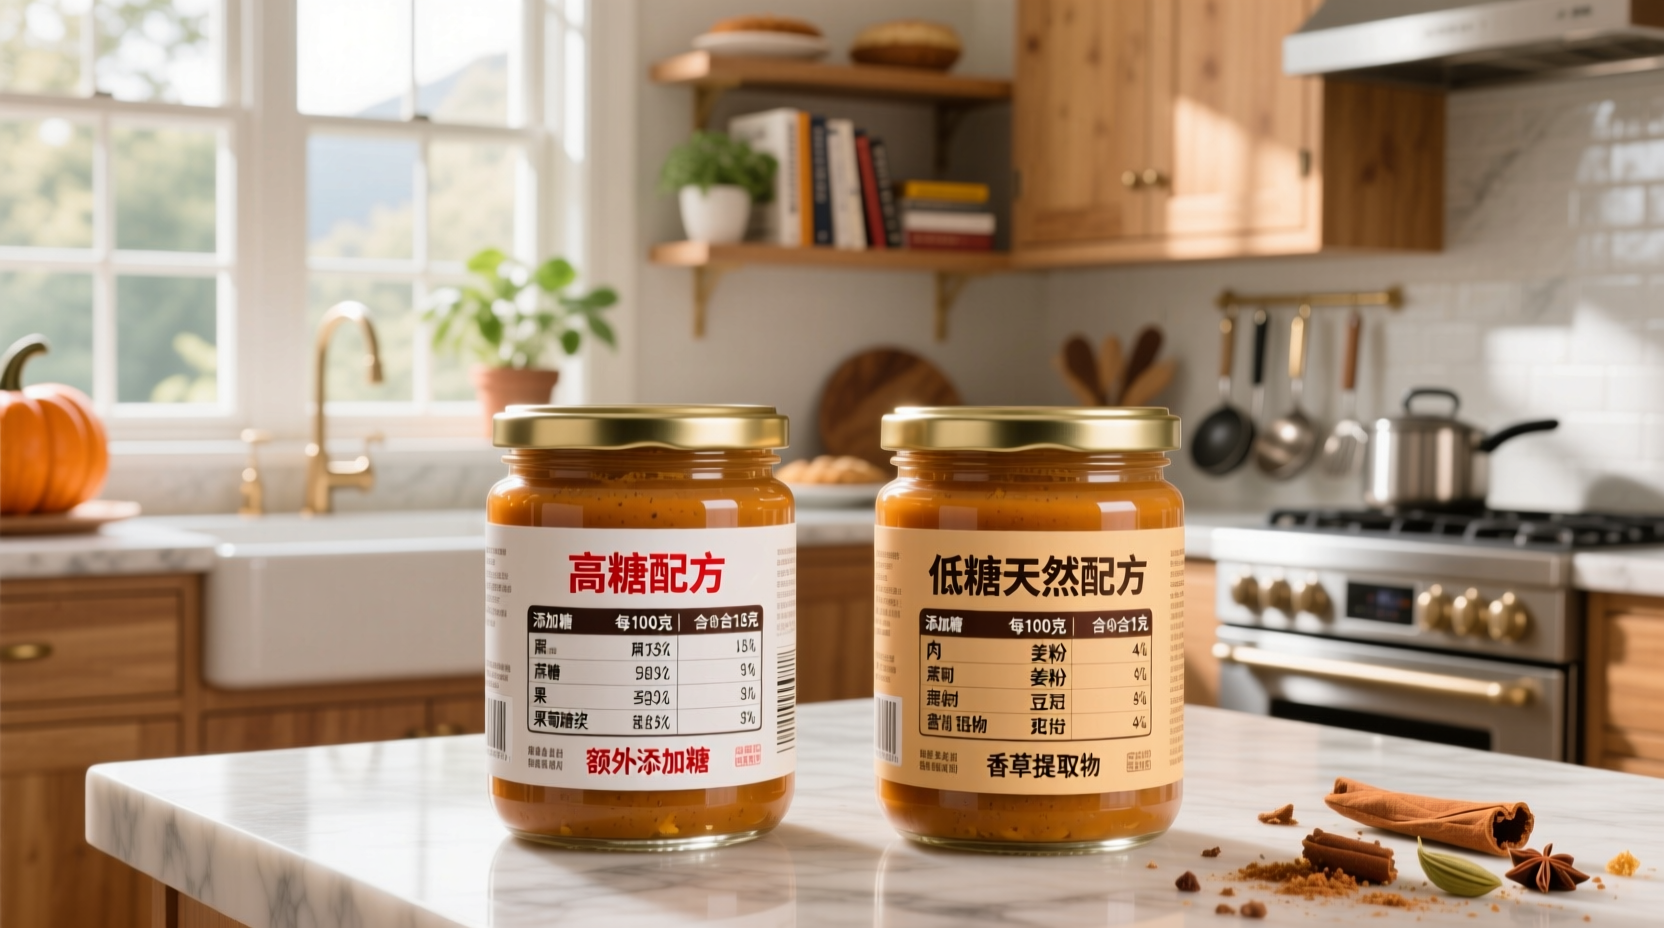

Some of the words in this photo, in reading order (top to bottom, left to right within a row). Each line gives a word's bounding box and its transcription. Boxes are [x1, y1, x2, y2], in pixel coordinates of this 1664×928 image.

[568, 551, 726, 595] 高糖配方
[928, 553, 1148, 597] 低糖天然配方
[533, 611, 573, 630] 添加糖
[615, 613, 673, 632] 每100克
[925, 614, 963, 633] 添加糖
[1008, 617, 1067, 635] 每100克
[533, 687, 547, 704] 果
[586, 746, 711, 776] 额外添加糖
[986, 752, 1101, 779] 香草提取物
